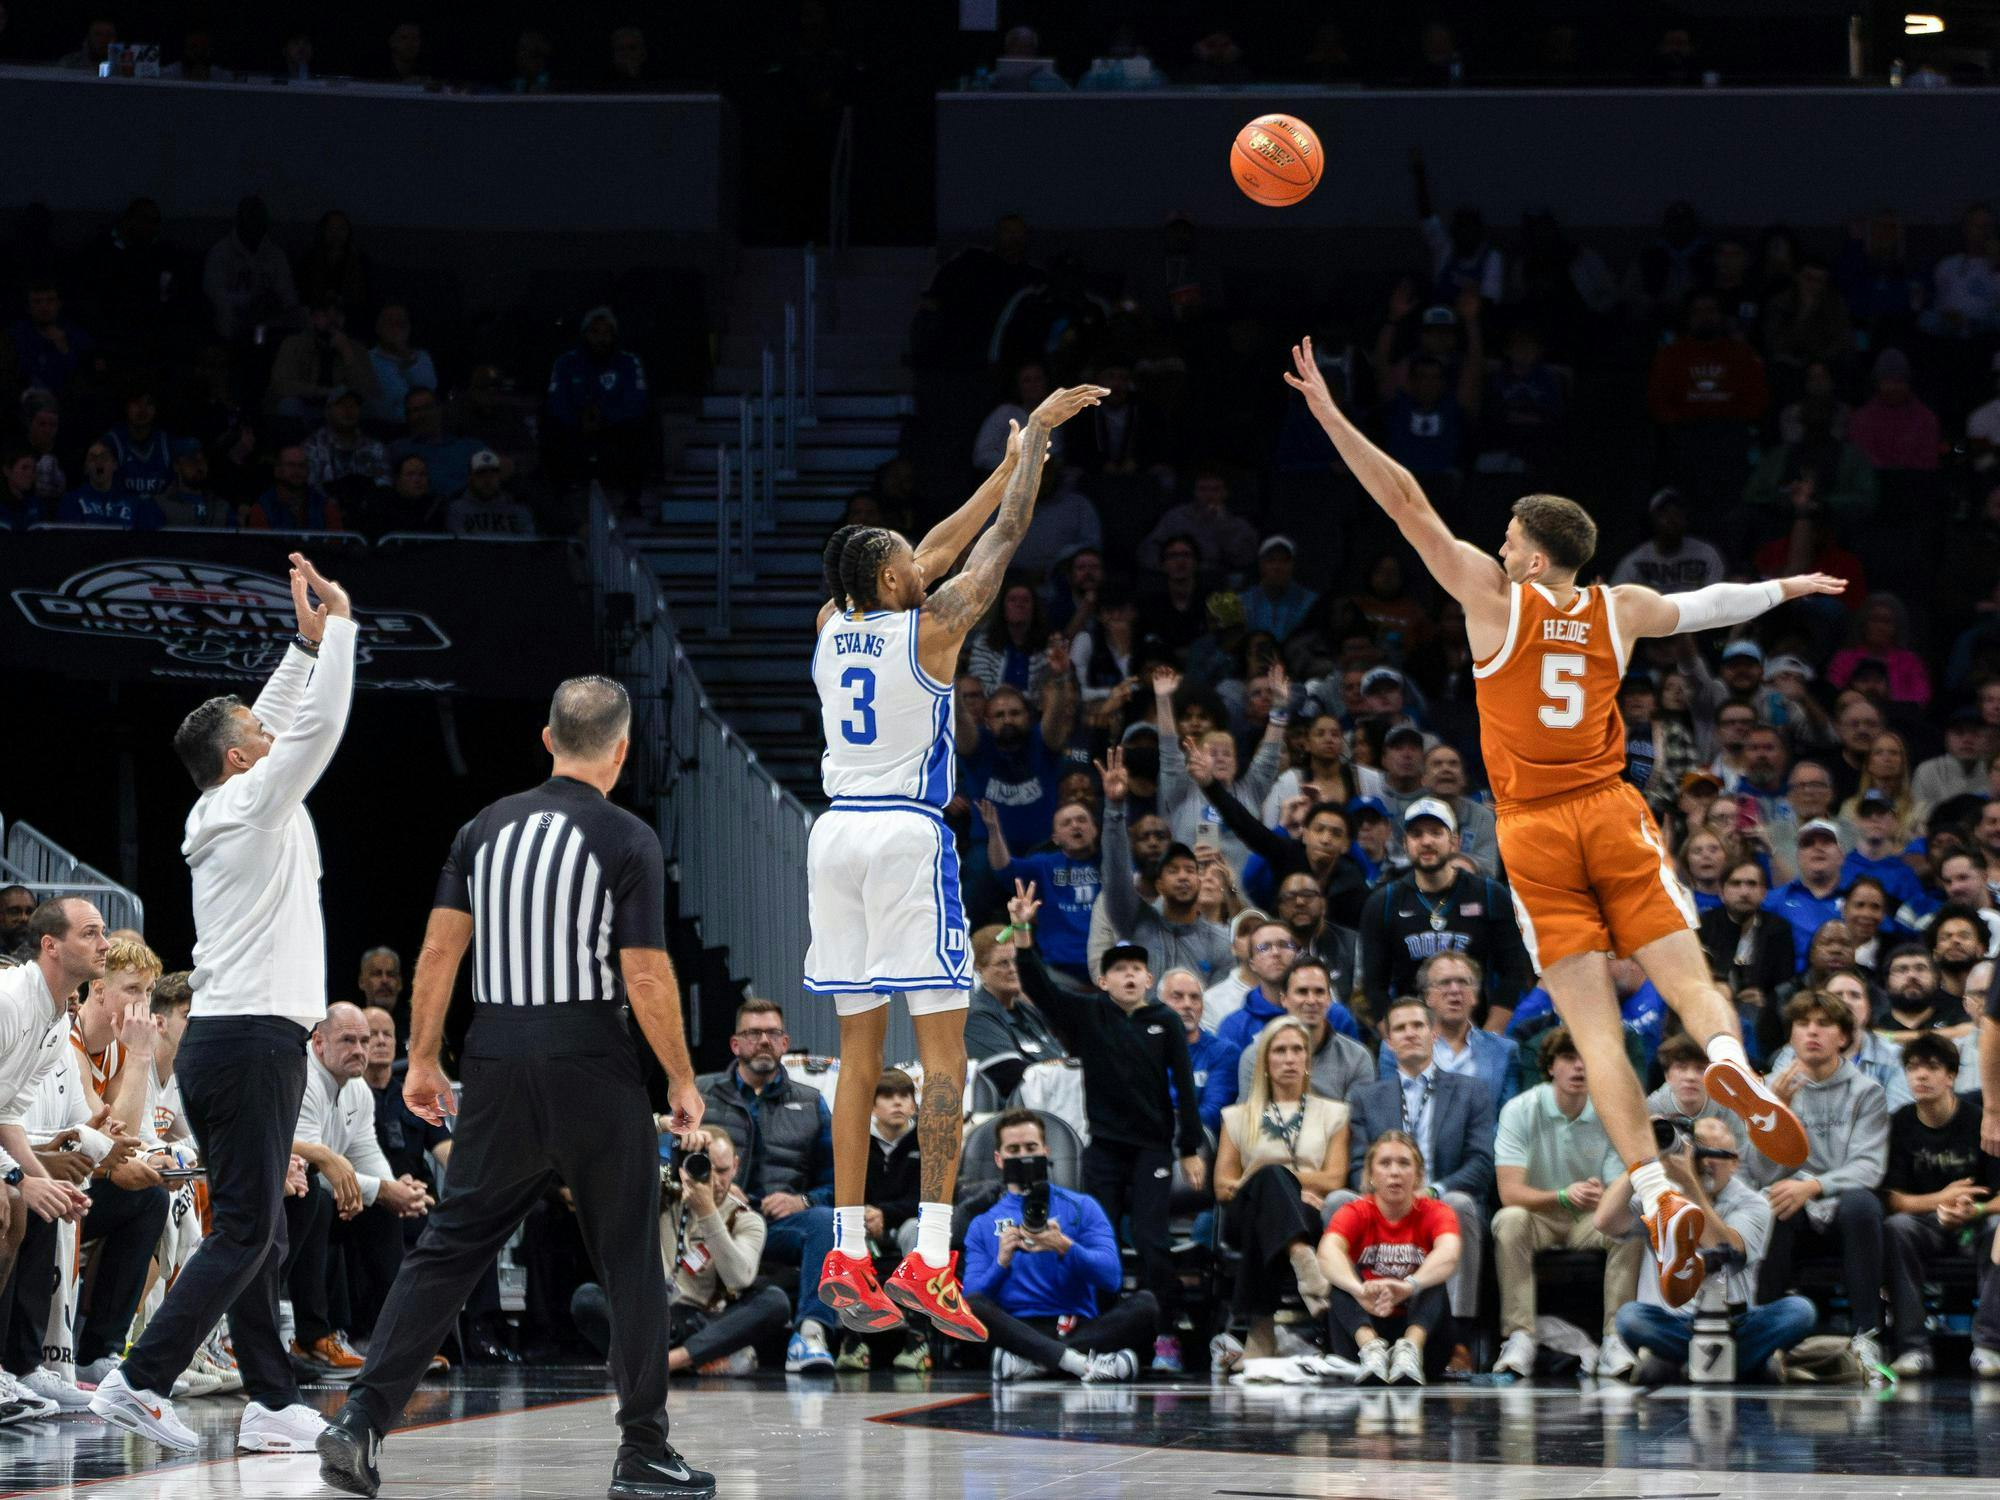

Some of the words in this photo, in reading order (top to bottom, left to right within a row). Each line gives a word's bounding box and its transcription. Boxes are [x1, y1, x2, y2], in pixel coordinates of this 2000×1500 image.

[149, 586, 267, 607] ESPN
[40, 597, 198, 624] DICK
[201, 606, 413, 634] VITE
[833, 632, 885, 658] EVANS
[1543, 619, 1592, 645] HEIDE
[840, 666, 877, 746] 3
[1538, 653, 1586, 729] 5
